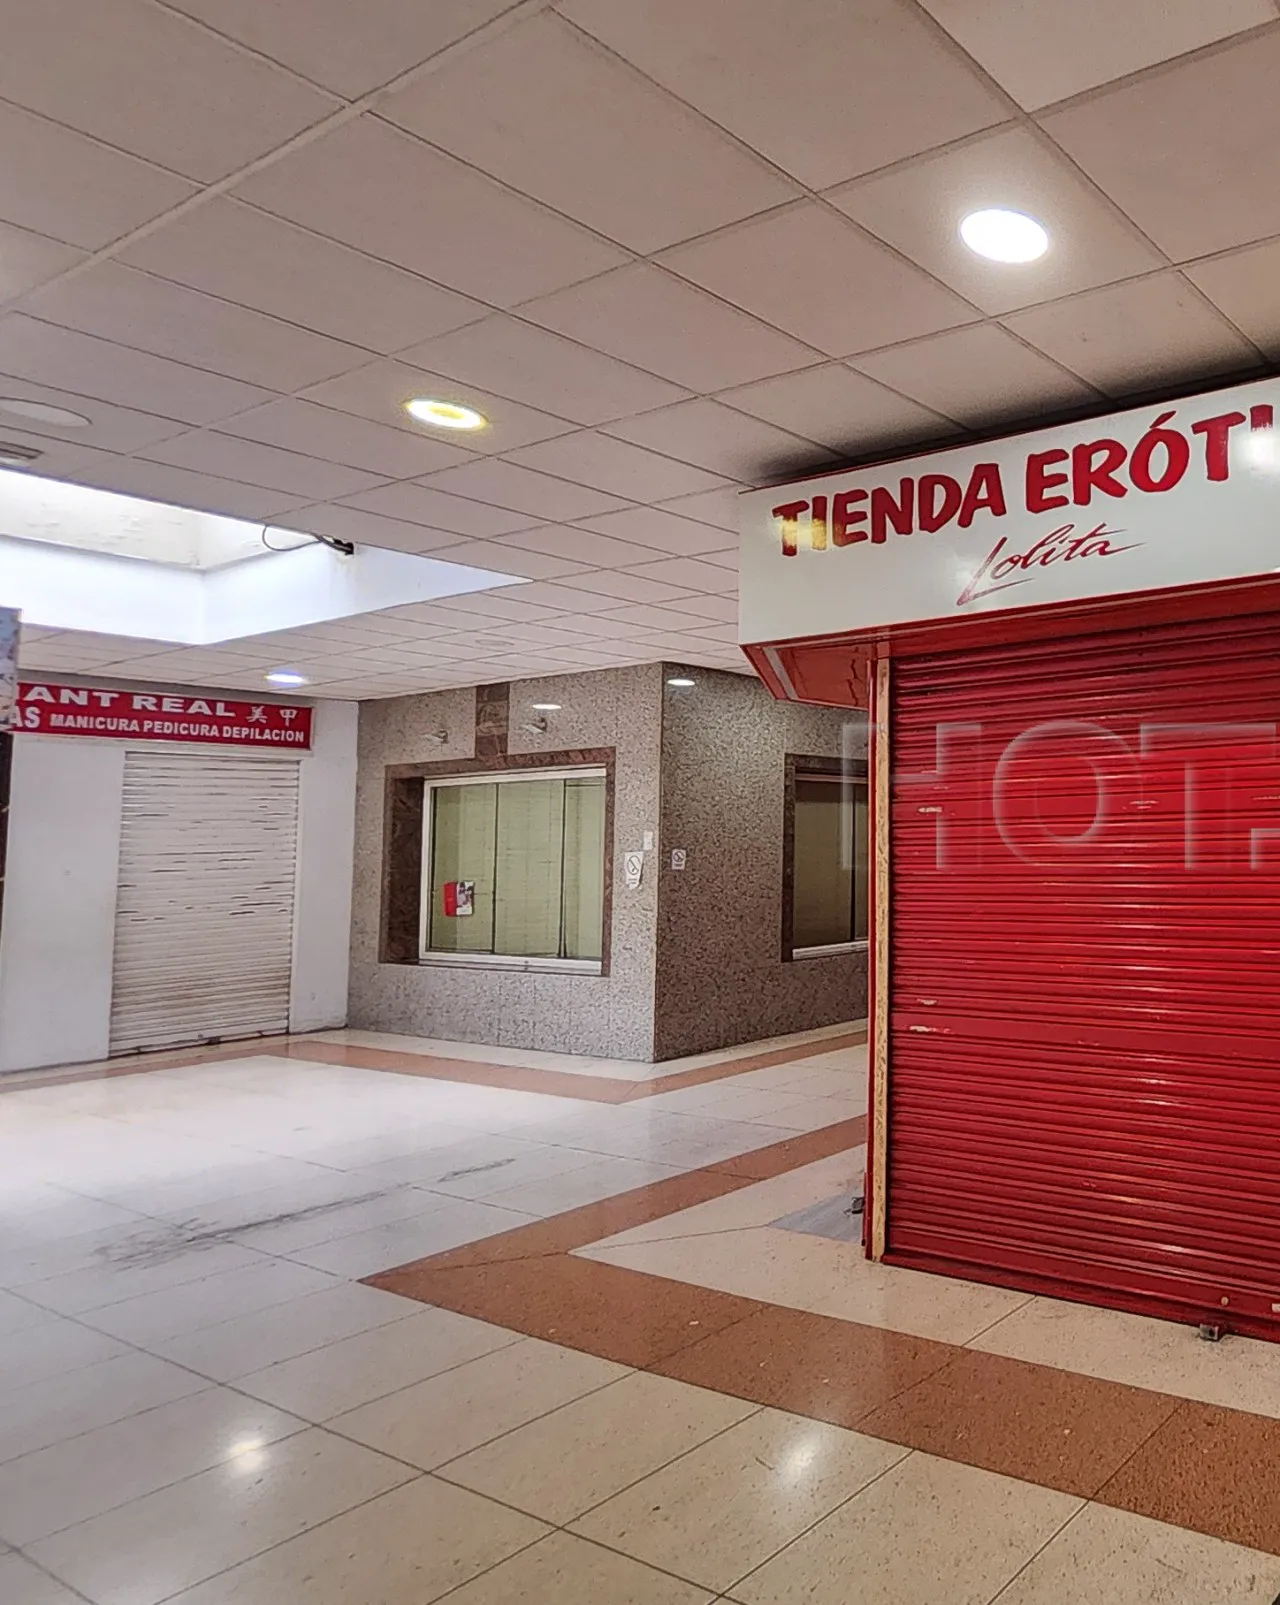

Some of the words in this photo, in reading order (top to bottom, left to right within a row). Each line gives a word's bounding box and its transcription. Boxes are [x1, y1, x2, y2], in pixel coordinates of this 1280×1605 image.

[772, 463, 1007, 557] TIENDA
[956, 522, 1147, 606] Lolita
[16, 685, 120, 708] ANT
[132, 695, 236, 717] REAL
[50, 713, 141, 732] MANICURA
[143, 720, 220, 738] PEDICURA
[222, 725, 305, 743] DEPILACION
